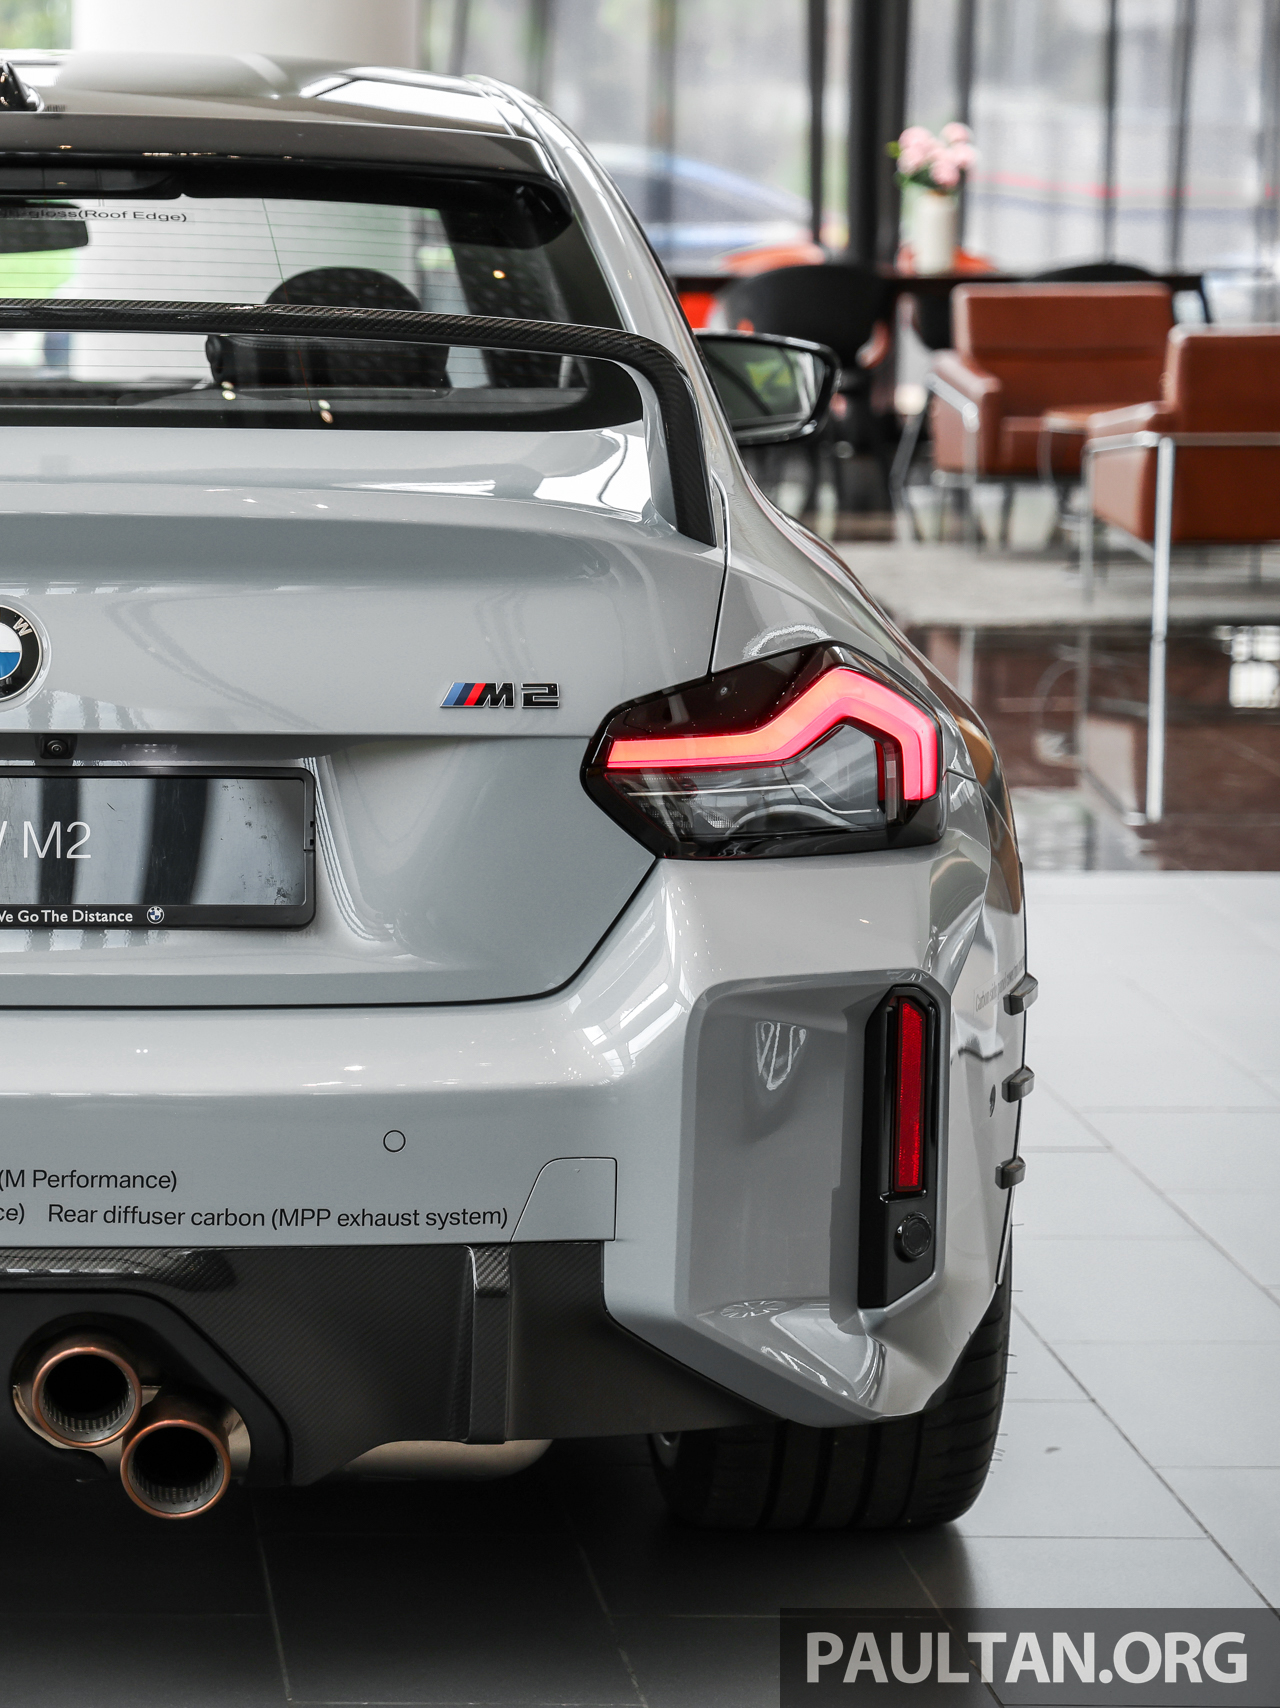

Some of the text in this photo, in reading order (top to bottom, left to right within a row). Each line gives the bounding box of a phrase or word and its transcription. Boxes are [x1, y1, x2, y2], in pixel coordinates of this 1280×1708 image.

[132, 210, 188, 222] Edge)
[472, 681, 560, 708] M2
[22, 820, 92, 860] M2
[17, 909, 39, 923] Go
[40, 909, 69, 923] The
[72, 908, 133, 924] Distance
[32, 1169, 177, 1193] Performance)
[48, 1203, 508, 1231] Rear diffuser carbon (MPP exhaust system)
